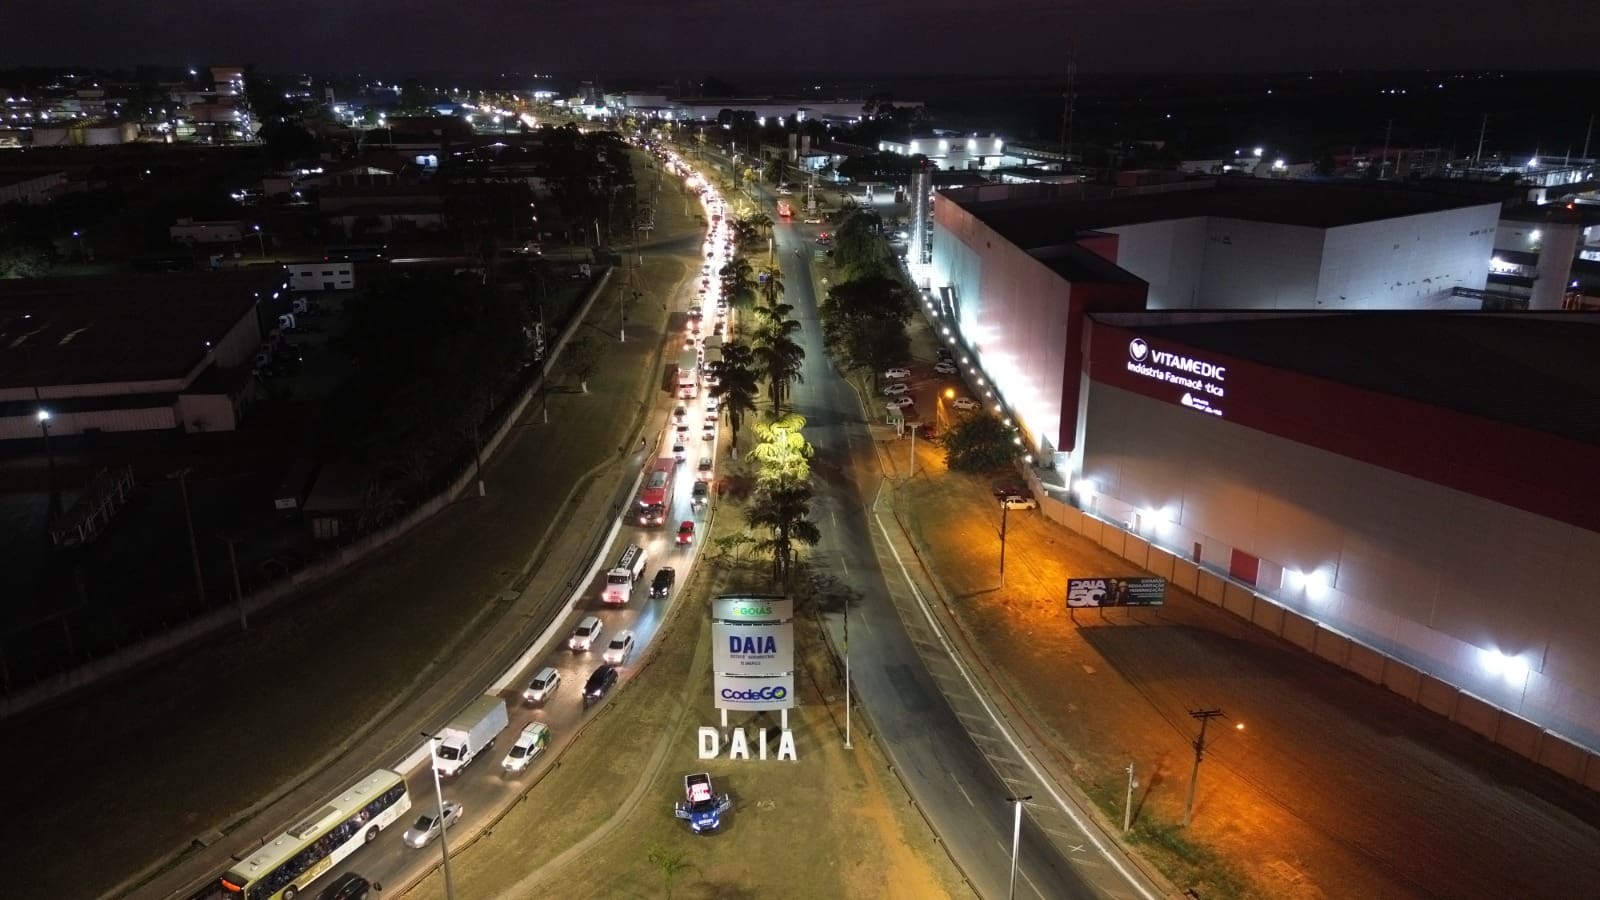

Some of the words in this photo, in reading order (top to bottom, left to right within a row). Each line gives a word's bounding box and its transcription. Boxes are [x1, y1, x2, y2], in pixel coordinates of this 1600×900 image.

[1127, 361, 1165, 381] Indústria
[1151, 349, 1226, 381] VITAMEDIC
[1070, 579, 1107, 590] DAIA
[729, 635, 777, 654] DAIA
[721, 686, 787, 701] CodeGO
[698, 726, 797, 761] DAIA
